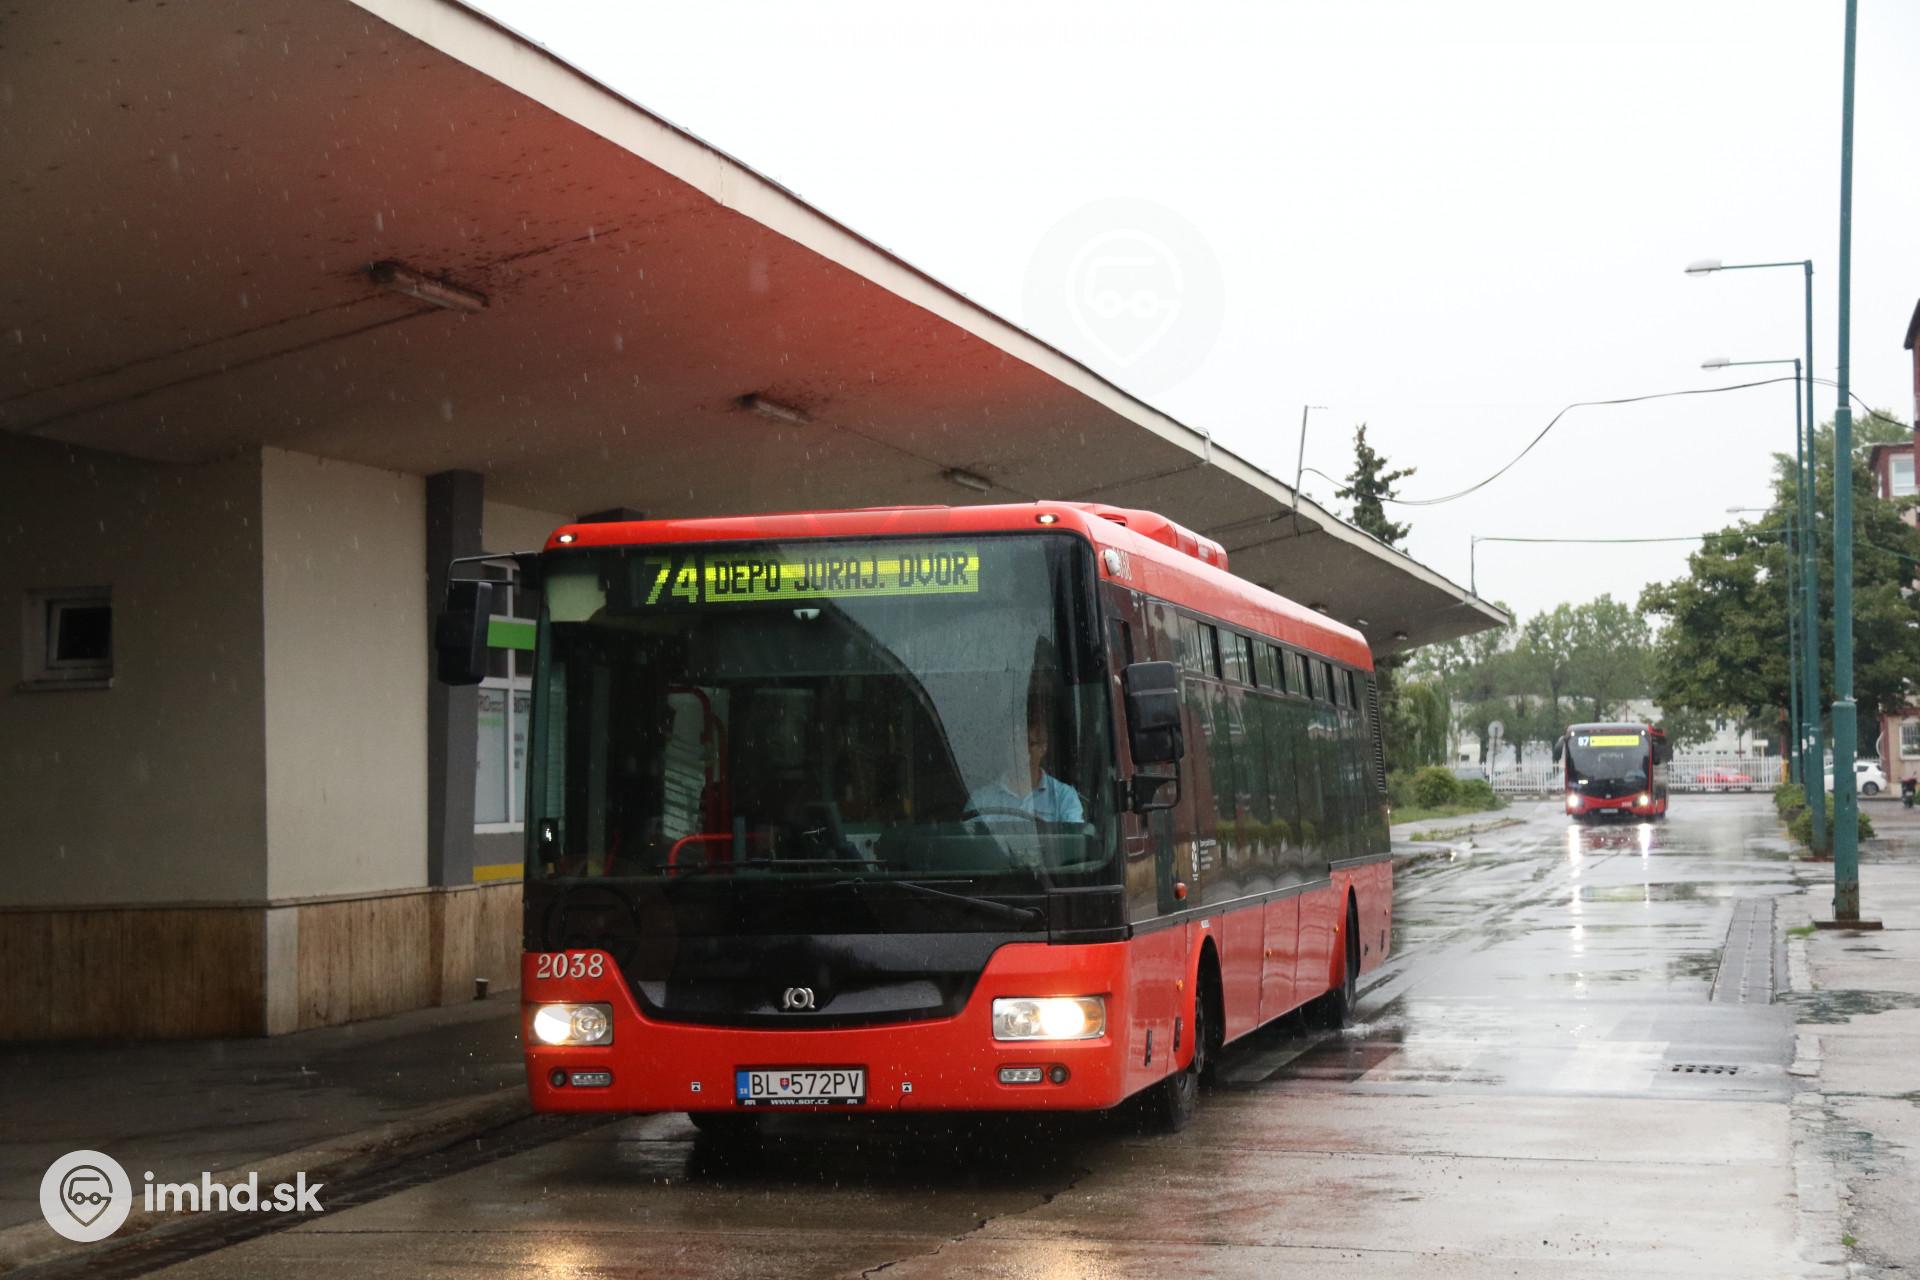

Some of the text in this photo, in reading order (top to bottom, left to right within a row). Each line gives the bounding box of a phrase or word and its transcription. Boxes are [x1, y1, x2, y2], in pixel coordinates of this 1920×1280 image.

[645, 551, 970, 604] 74 DEPO JURAJ. DVOR
[536, 953, 604, 978] 2038
